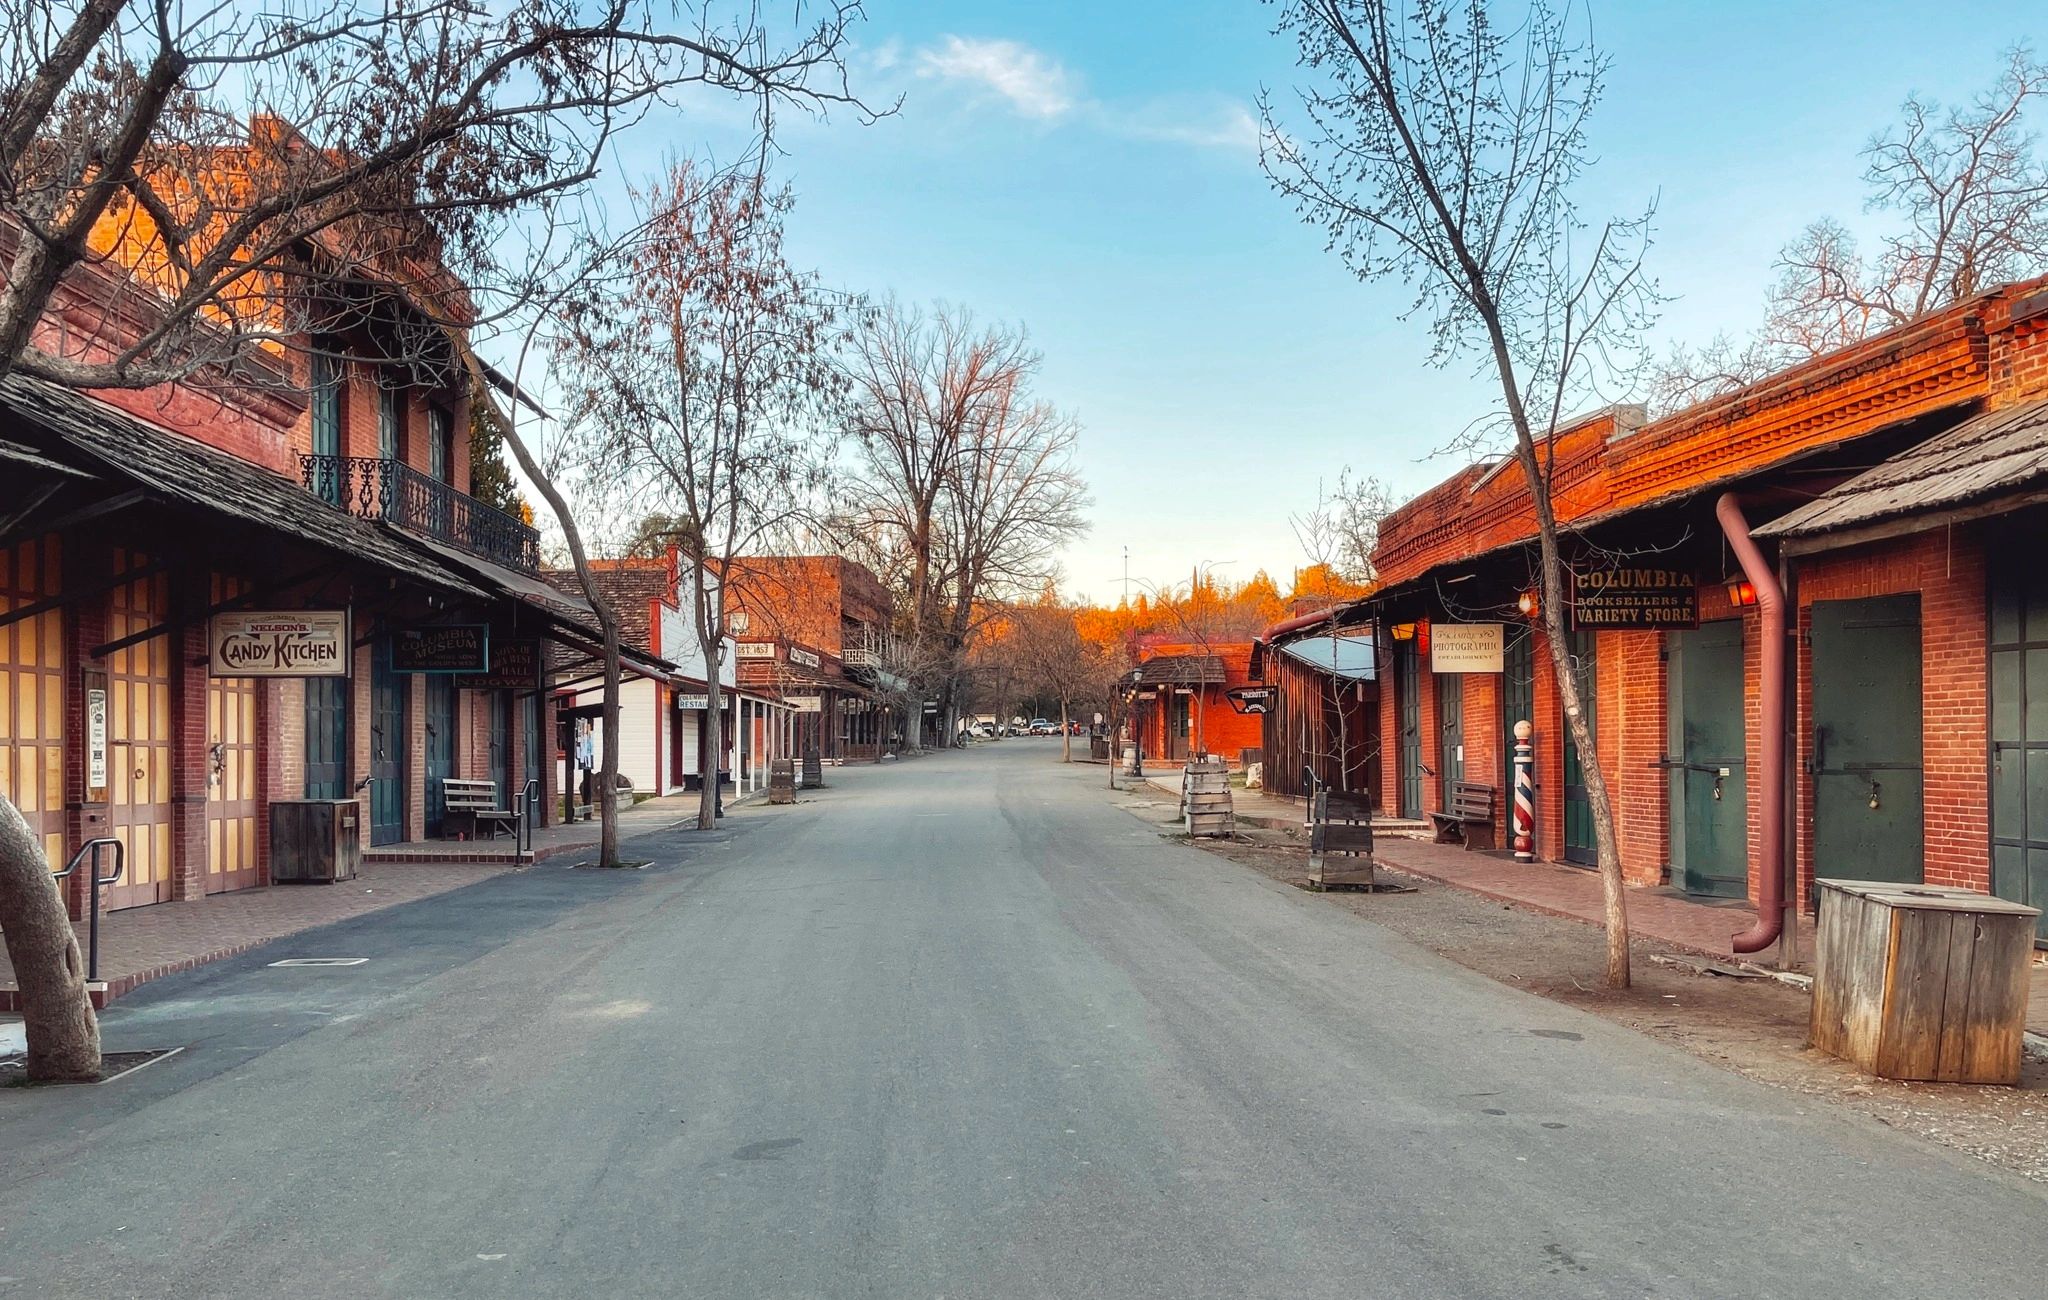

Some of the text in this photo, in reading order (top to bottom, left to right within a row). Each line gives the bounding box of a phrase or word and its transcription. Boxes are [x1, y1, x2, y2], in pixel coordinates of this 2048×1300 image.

[1577, 569, 1694, 589] COLUMBIA
[1577, 596, 1694, 606] BOOKSELLERS &
[1577, 607, 1695, 623] VARIETY STORE.
[401, 629, 475, 652] COLUMBIA
[415, 639, 477, 660] MUSEUM
